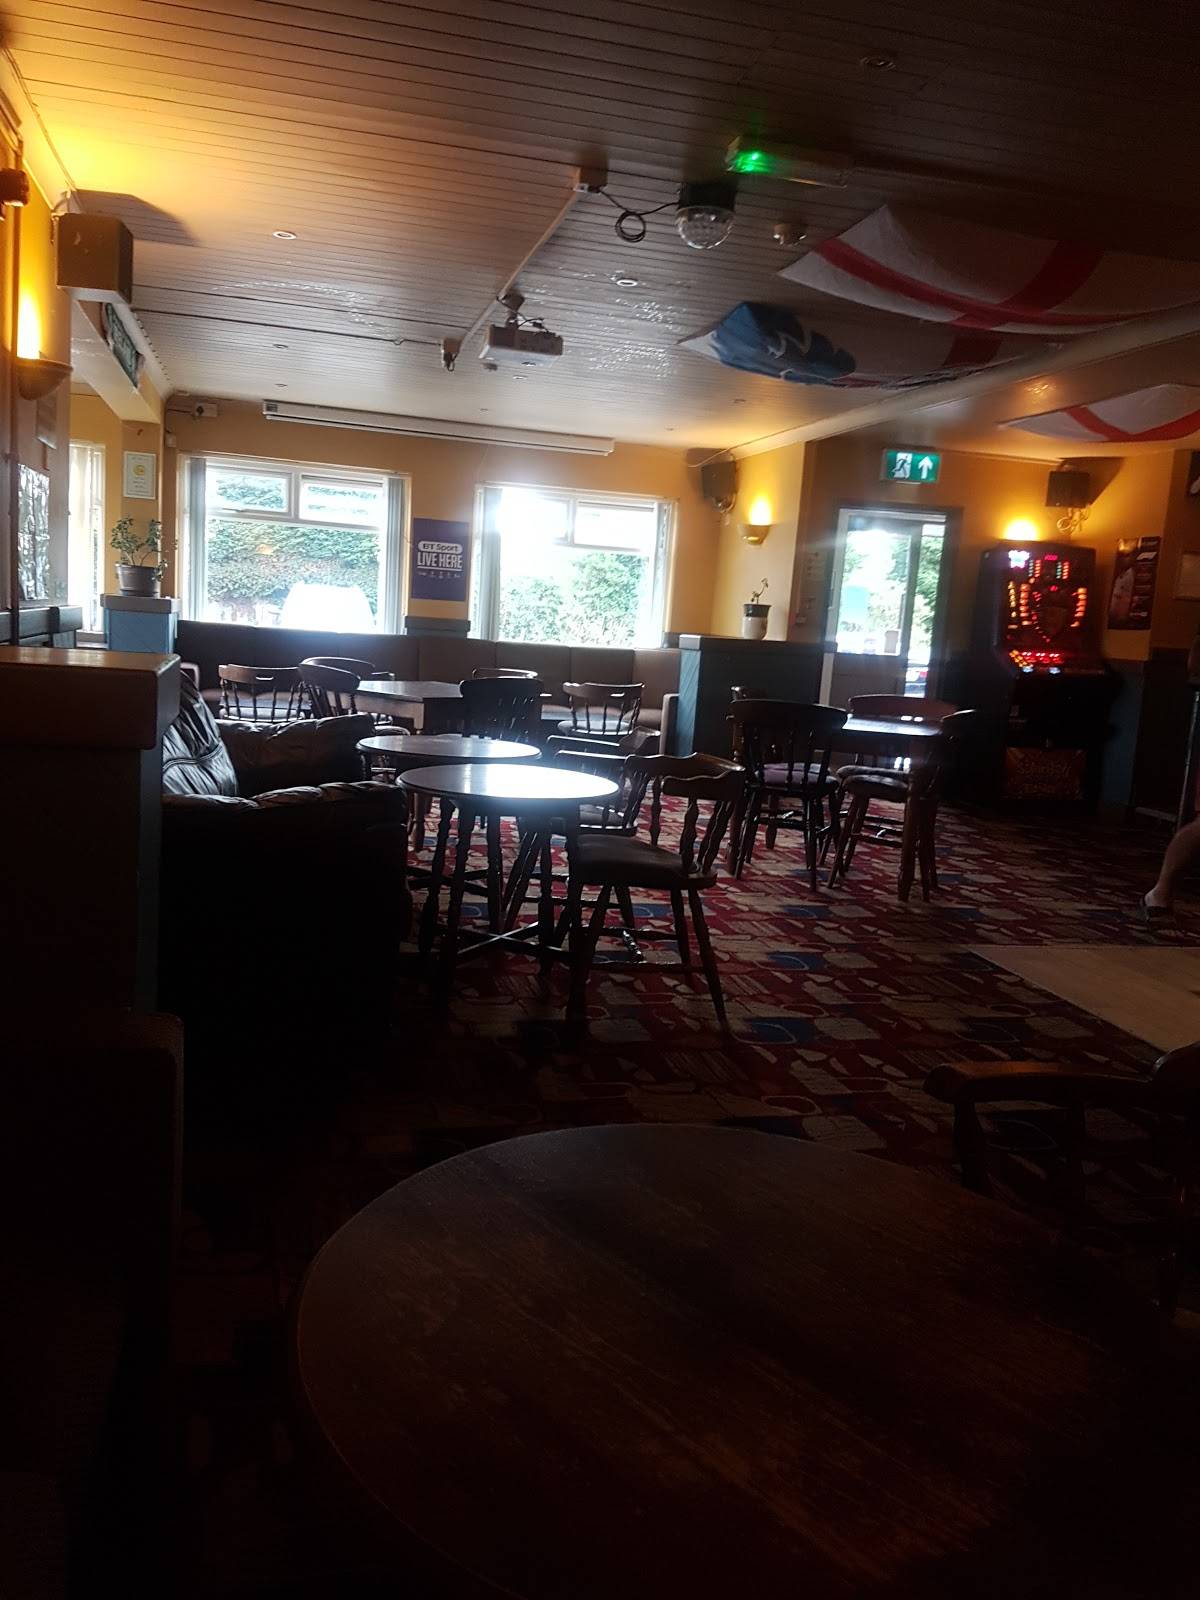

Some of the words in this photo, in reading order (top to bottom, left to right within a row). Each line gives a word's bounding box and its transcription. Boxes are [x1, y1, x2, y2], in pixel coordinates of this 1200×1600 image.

[436, 544, 459, 552] Sport
[417, 551, 437, 566] LIVE
[439, 553, 463, 569] HERE
